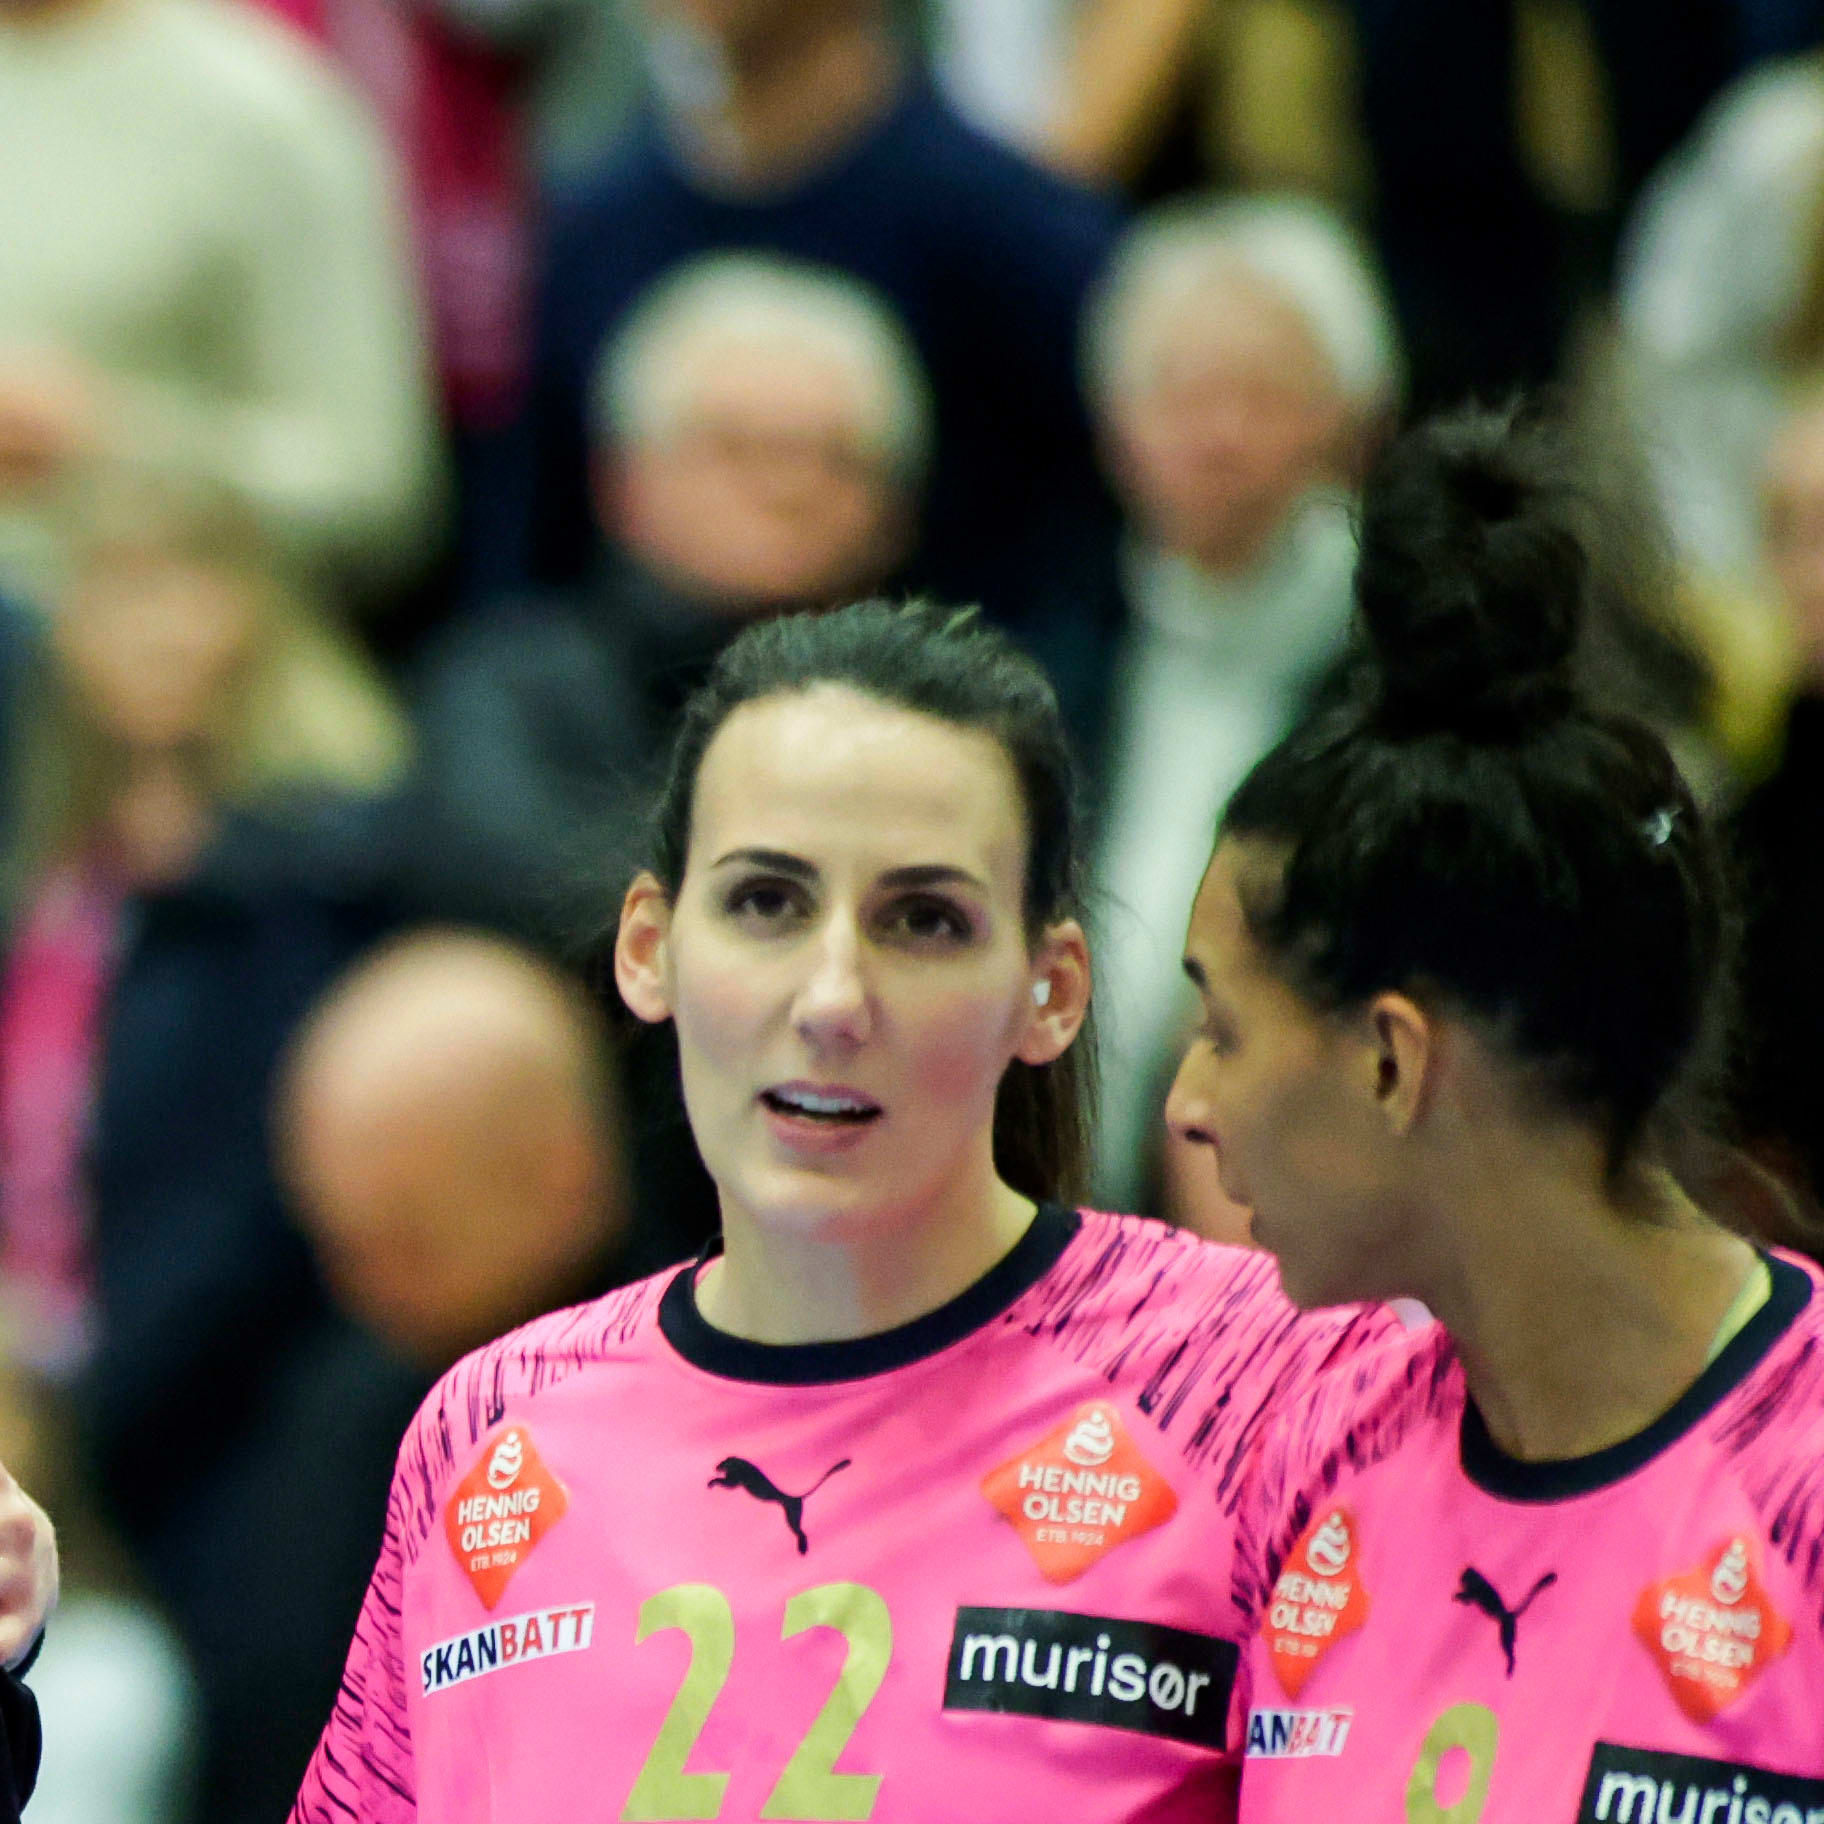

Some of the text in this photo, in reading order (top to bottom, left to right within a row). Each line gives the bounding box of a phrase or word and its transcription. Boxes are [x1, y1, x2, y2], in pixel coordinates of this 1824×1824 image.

[1018, 1464, 1142, 1502] HENNIG
[458, 1487, 541, 1526] HENNIG
[1022, 1492, 1128, 1528] OLSEN
[461, 1517, 532, 1552] OLSEN
[423, 1607, 592, 1692] SKANBATT
[956, 1628, 1211, 1718] murisør
[618, 1581, 894, 1823] 22
